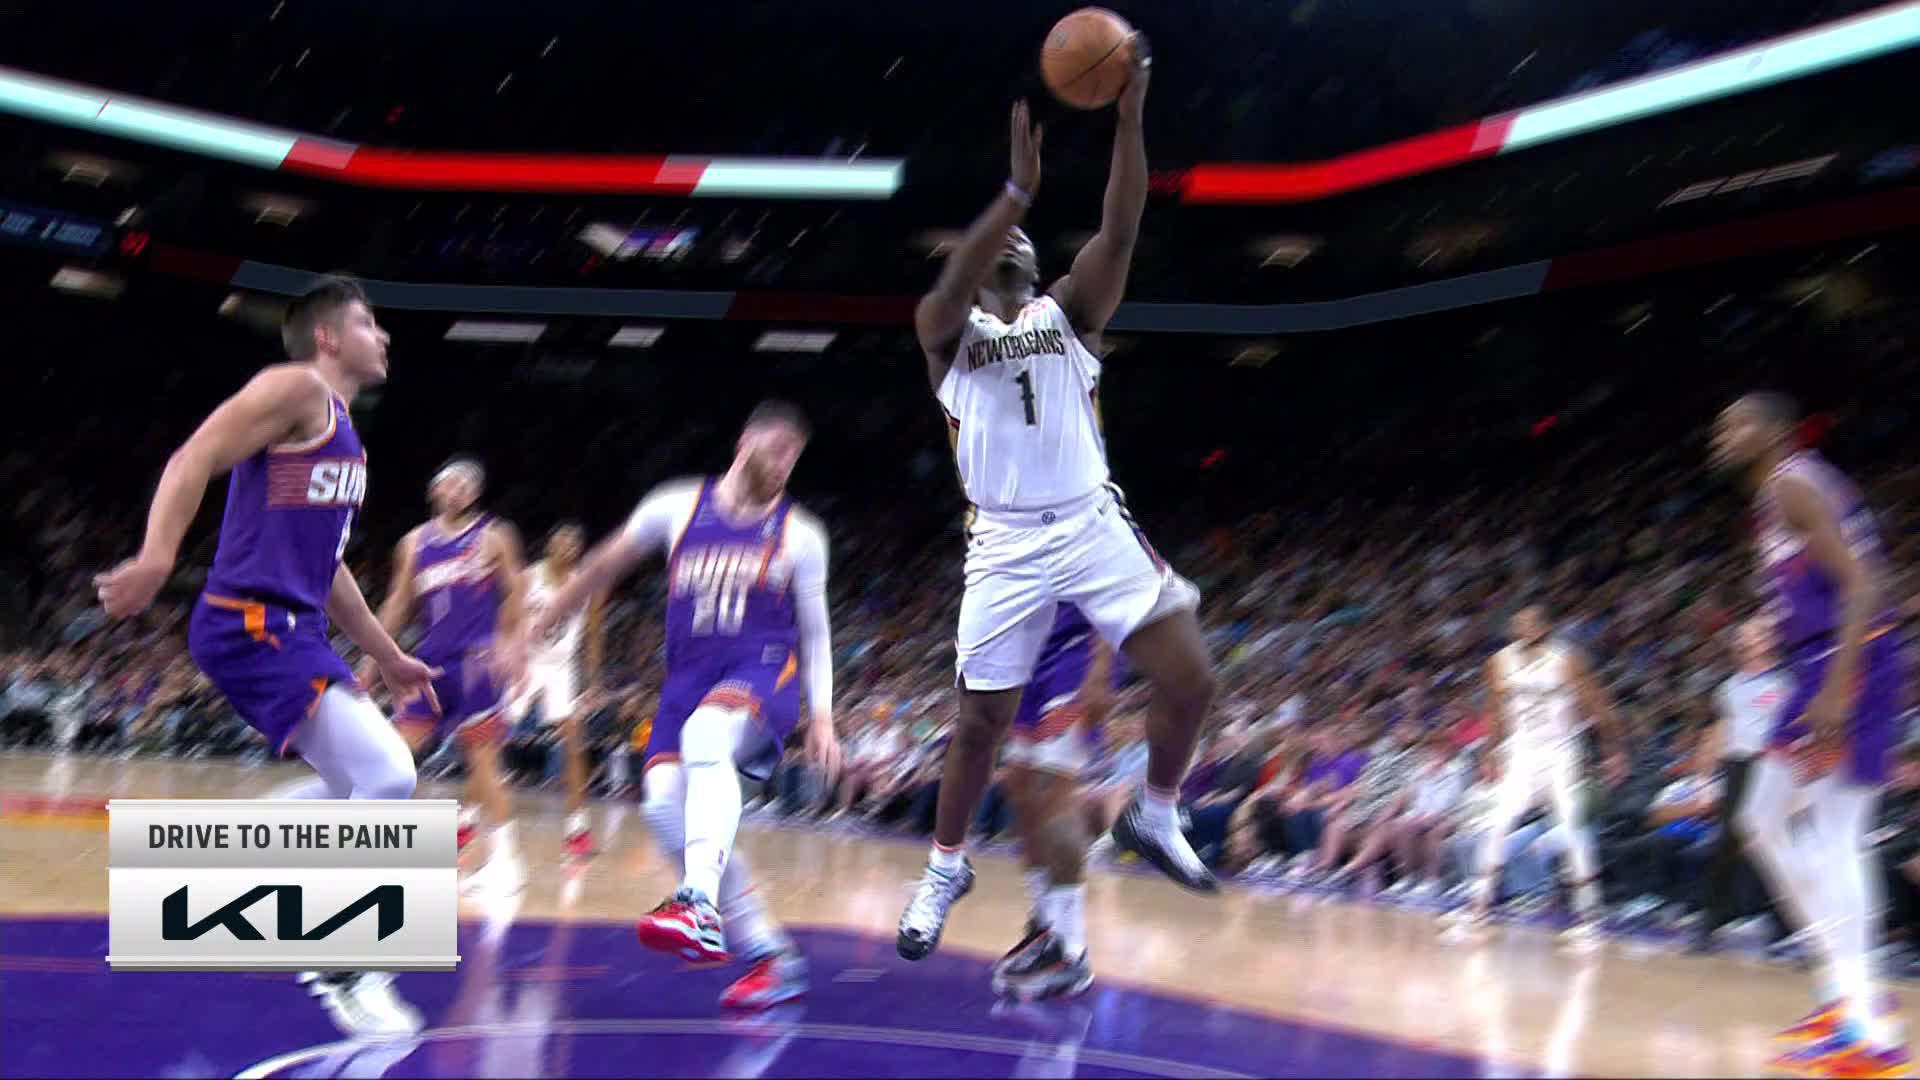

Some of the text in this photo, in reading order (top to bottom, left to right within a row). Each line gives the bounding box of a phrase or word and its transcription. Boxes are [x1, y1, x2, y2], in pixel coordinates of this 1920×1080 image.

[967, 329, 1065, 372] NEW ORLEANS
[1015, 370, 1037, 425] 1
